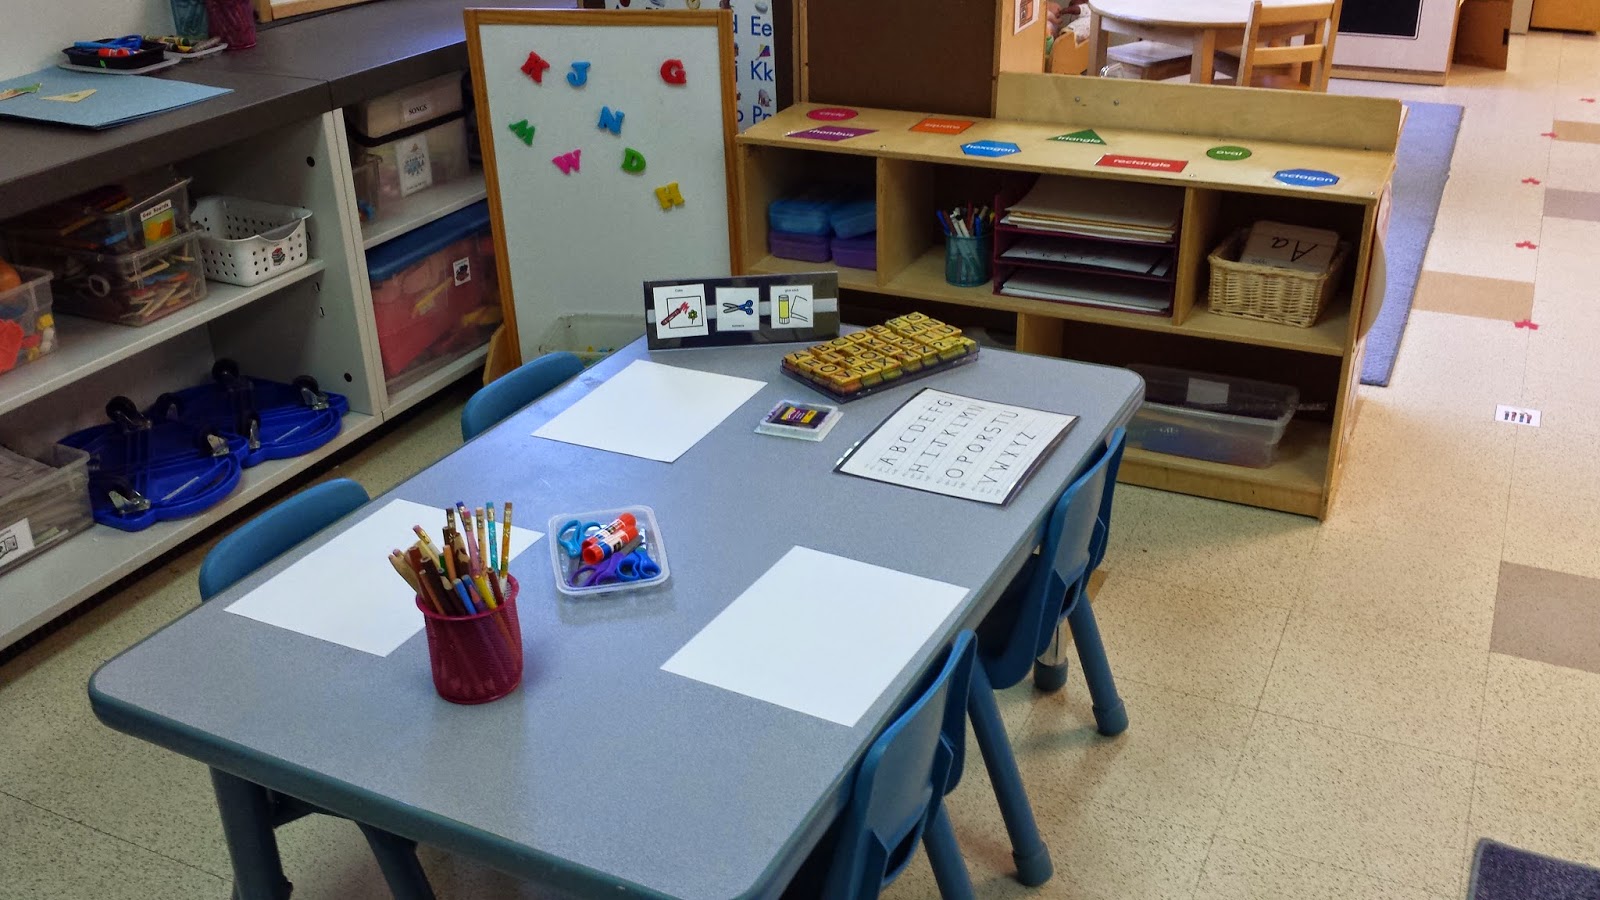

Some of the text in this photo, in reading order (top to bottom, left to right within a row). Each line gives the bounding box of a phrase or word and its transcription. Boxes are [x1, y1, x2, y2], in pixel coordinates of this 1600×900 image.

[750, 16, 772, 36] Ee
[567, 62, 591, 87] J
[660, 59, 687, 84] G
[750, 61, 774, 82] Kk
[597, 106, 625, 135] N
[808, 129, 855, 137] rhombus
[1057, 135, 1102, 144] triangle
[966, 144, 1016, 153] hexagon
[621, 147, 646, 174] D
[1113, 158, 1171, 168] rectangle
[1280, 172, 1334, 183] octagon
